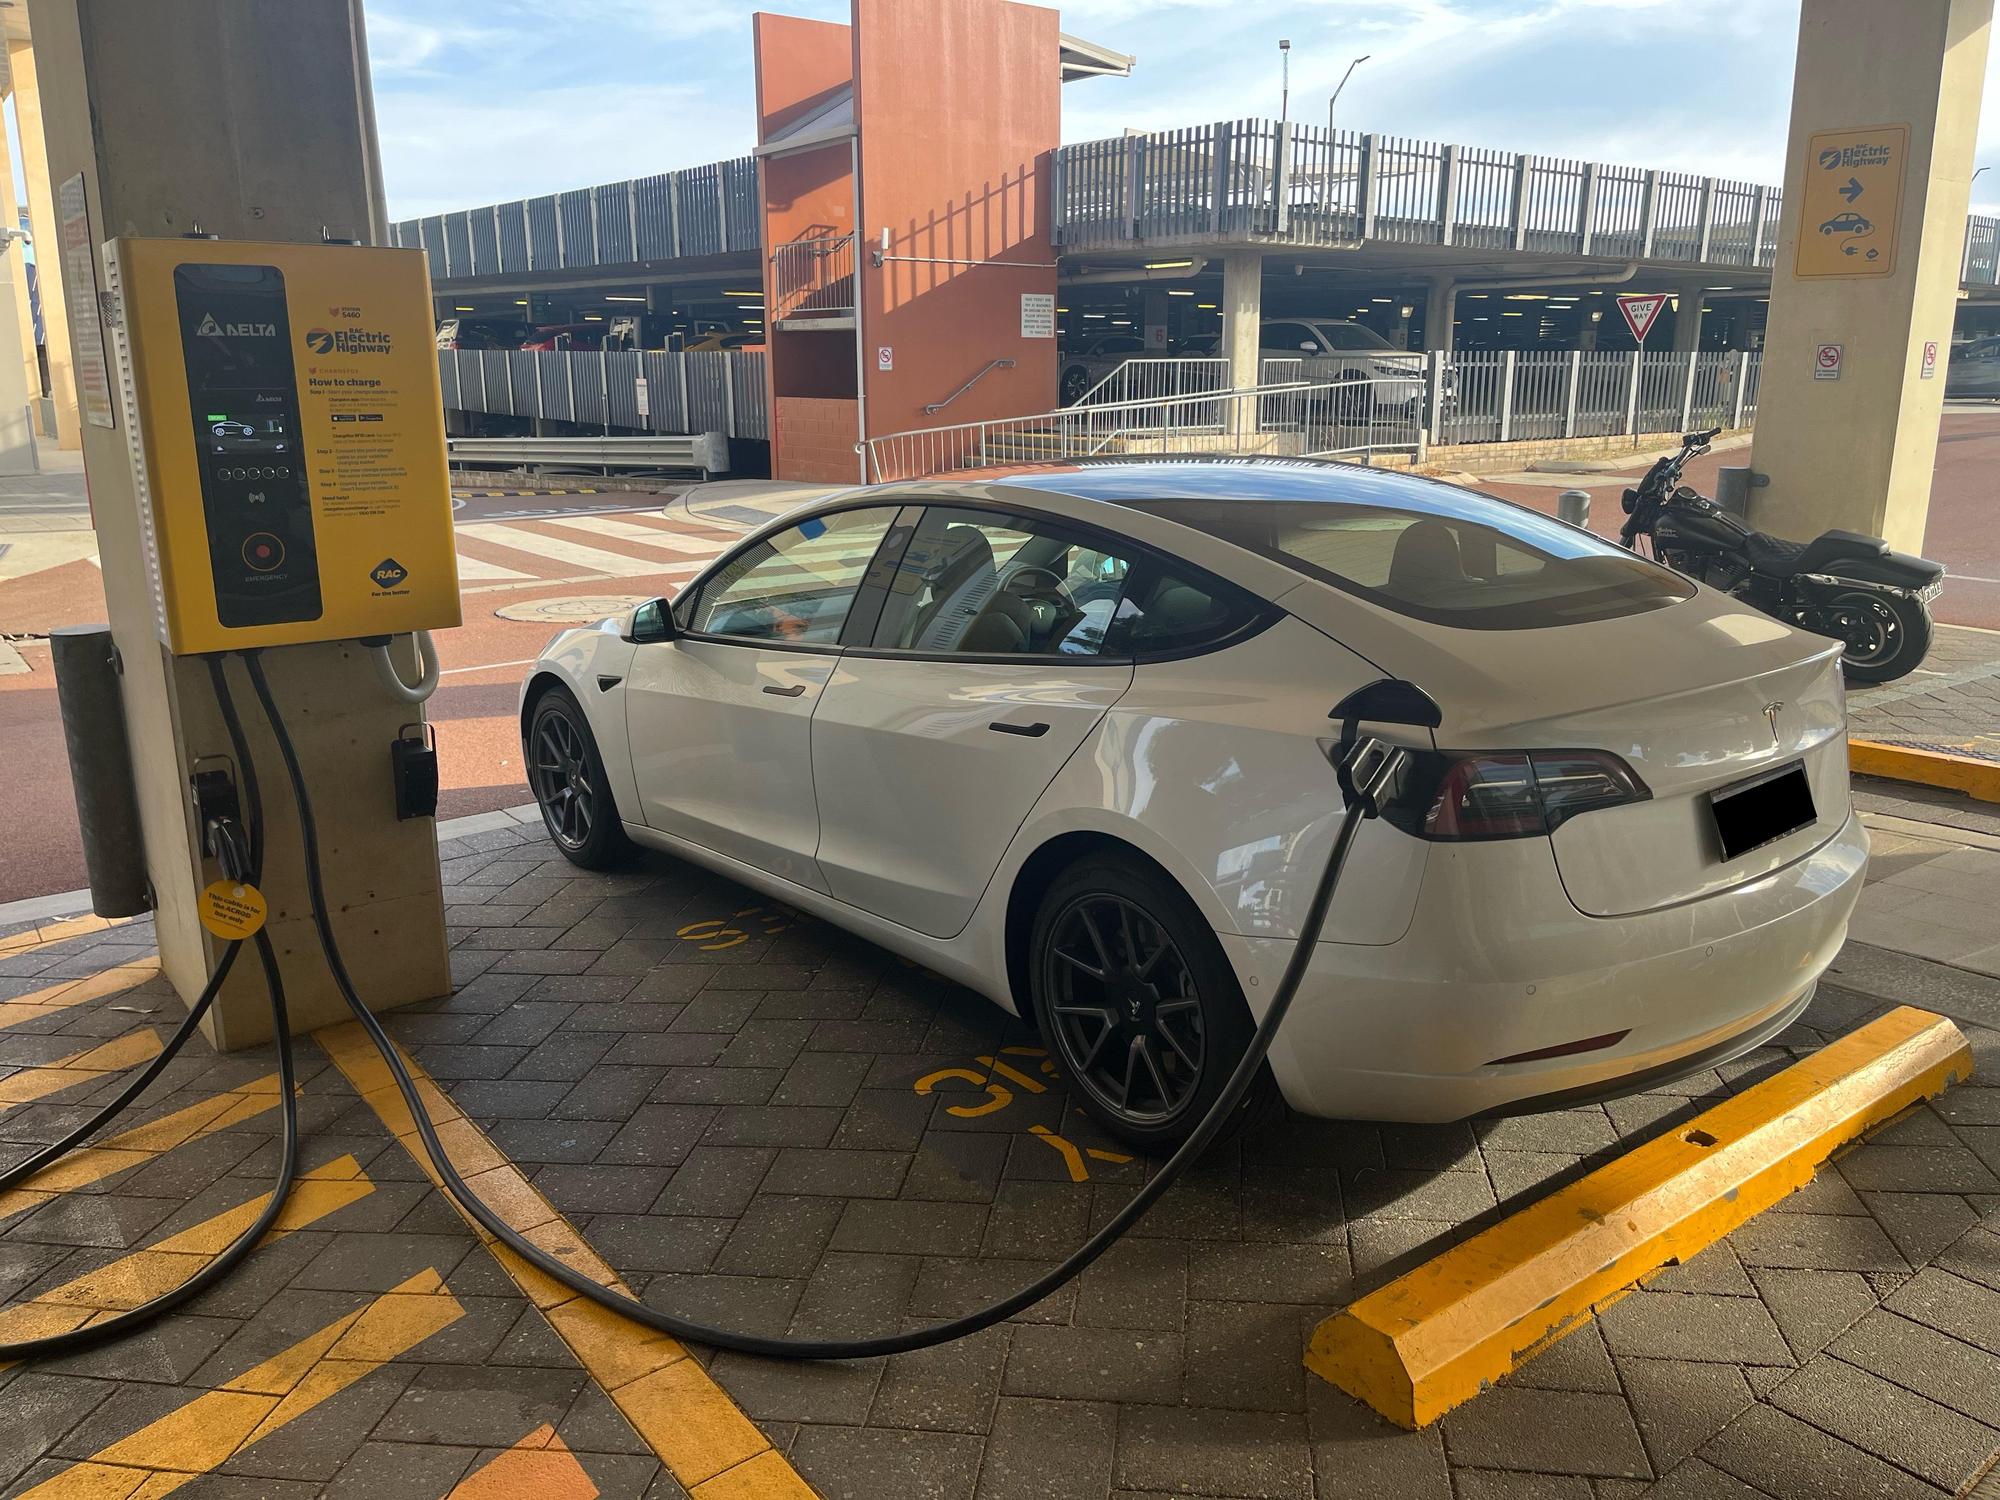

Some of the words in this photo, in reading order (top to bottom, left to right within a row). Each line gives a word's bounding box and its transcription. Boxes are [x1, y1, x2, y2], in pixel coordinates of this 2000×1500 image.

[1842, 145, 1890, 159] Electric
[1841, 156, 1890, 168] Highway
[1631, 304, 1652, 312] GIVE
[226, 324, 276, 336] DELTA
[335, 331, 391, 343] Electric
[336, 342, 391, 354] Highway
[309, 378, 333, 386] How
[334, 378, 345, 386] to
[346, 378, 381, 387] charge
[376, 569, 401, 579] RAC
[208, 892, 223, 902] This
[223, 898, 243, 908] cable
[250, 906, 261, 914] for
[213, 902, 225, 910] the
[225, 907, 252, 918] ACROD
[228, 916, 245, 925] only
